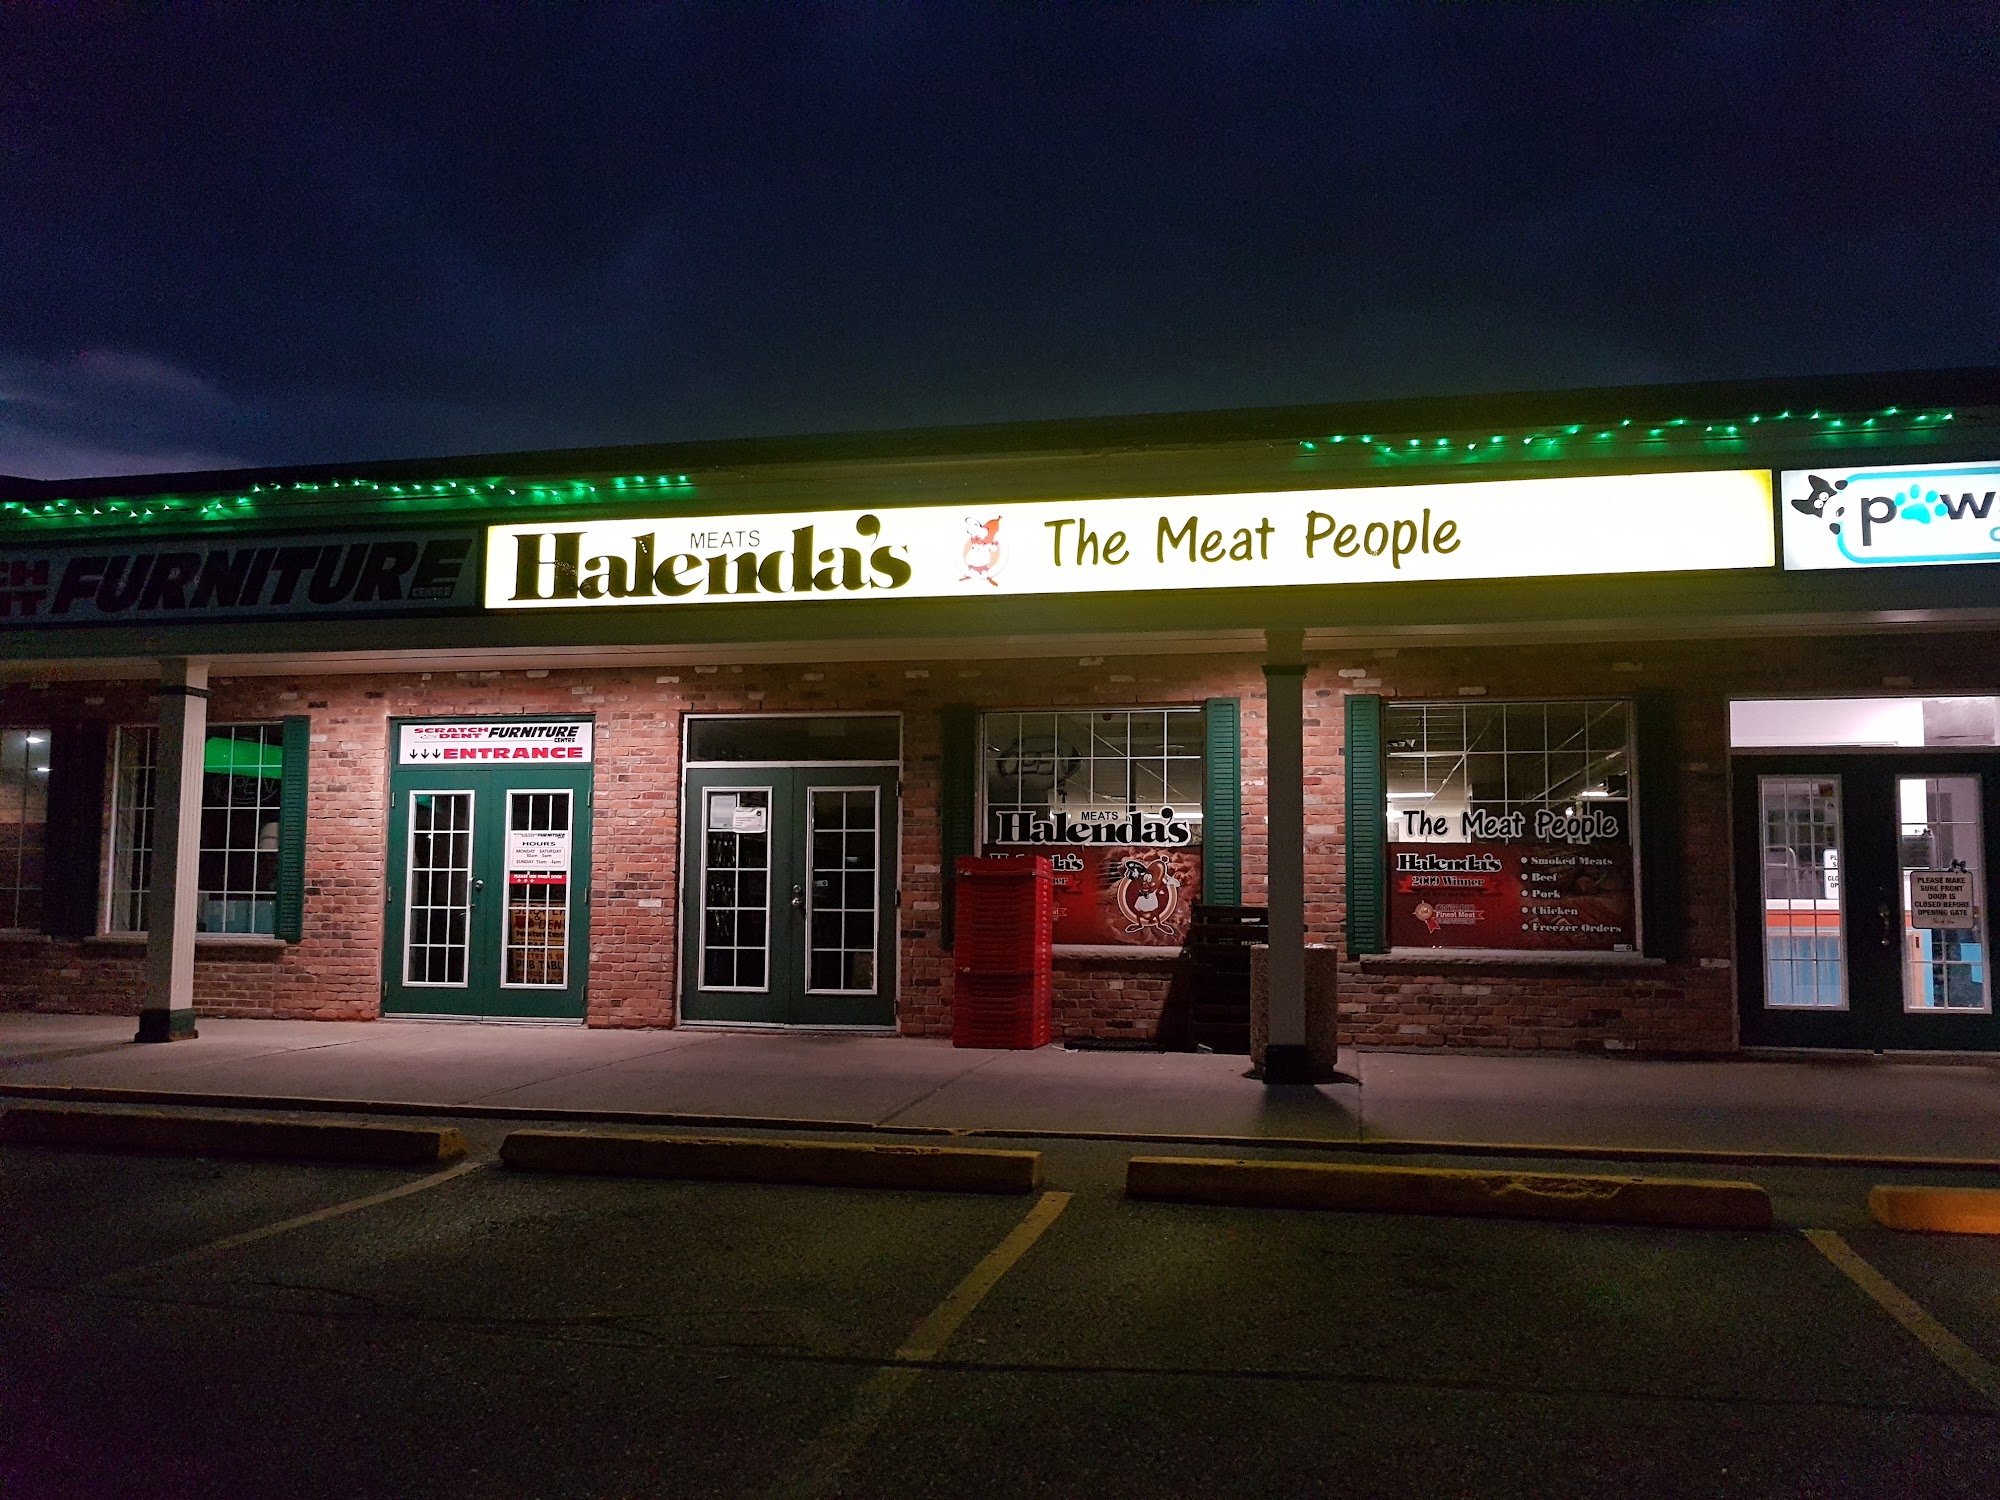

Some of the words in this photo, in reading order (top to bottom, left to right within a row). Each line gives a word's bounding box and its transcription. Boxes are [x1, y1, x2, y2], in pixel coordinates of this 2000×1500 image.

[690, 529, 762, 549] MEATS
[1044, 517, 1129, 566] The
[1157, 515, 1275, 564] Meat
[1305, 508, 1461, 569] People
[508, 514, 912, 601] Halenda's
[50, 538, 473, 615] FURNITURE
[488, 726, 580, 738] FURNITURE
[443, 746, 583, 760] ENTRANCE
[1081, 811, 1119, 821] MEATS
[996, 806, 1191, 846] Halenda's
[1402, 809, 1449, 838] The
[1460, 808, 1526, 839] Meat
[1535, 808, 1619, 844] People
[1396, 852, 1503, 873] Halenda's
[1531, 856, 1576, 865] Smoked
[1578, 857, 1613, 866] Meats
[1411, 876, 1440, 887] 2009
[1442, 876, 1485, 887] Winner
[1531, 872, 1558, 882] Beef
[1531, 889, 1561, 899] Pork
[1531, 906, 1579, 916] Chicken
[1532, 922, 1579, 932] Freezer
[1581, 924, 1622, 933] Orders
